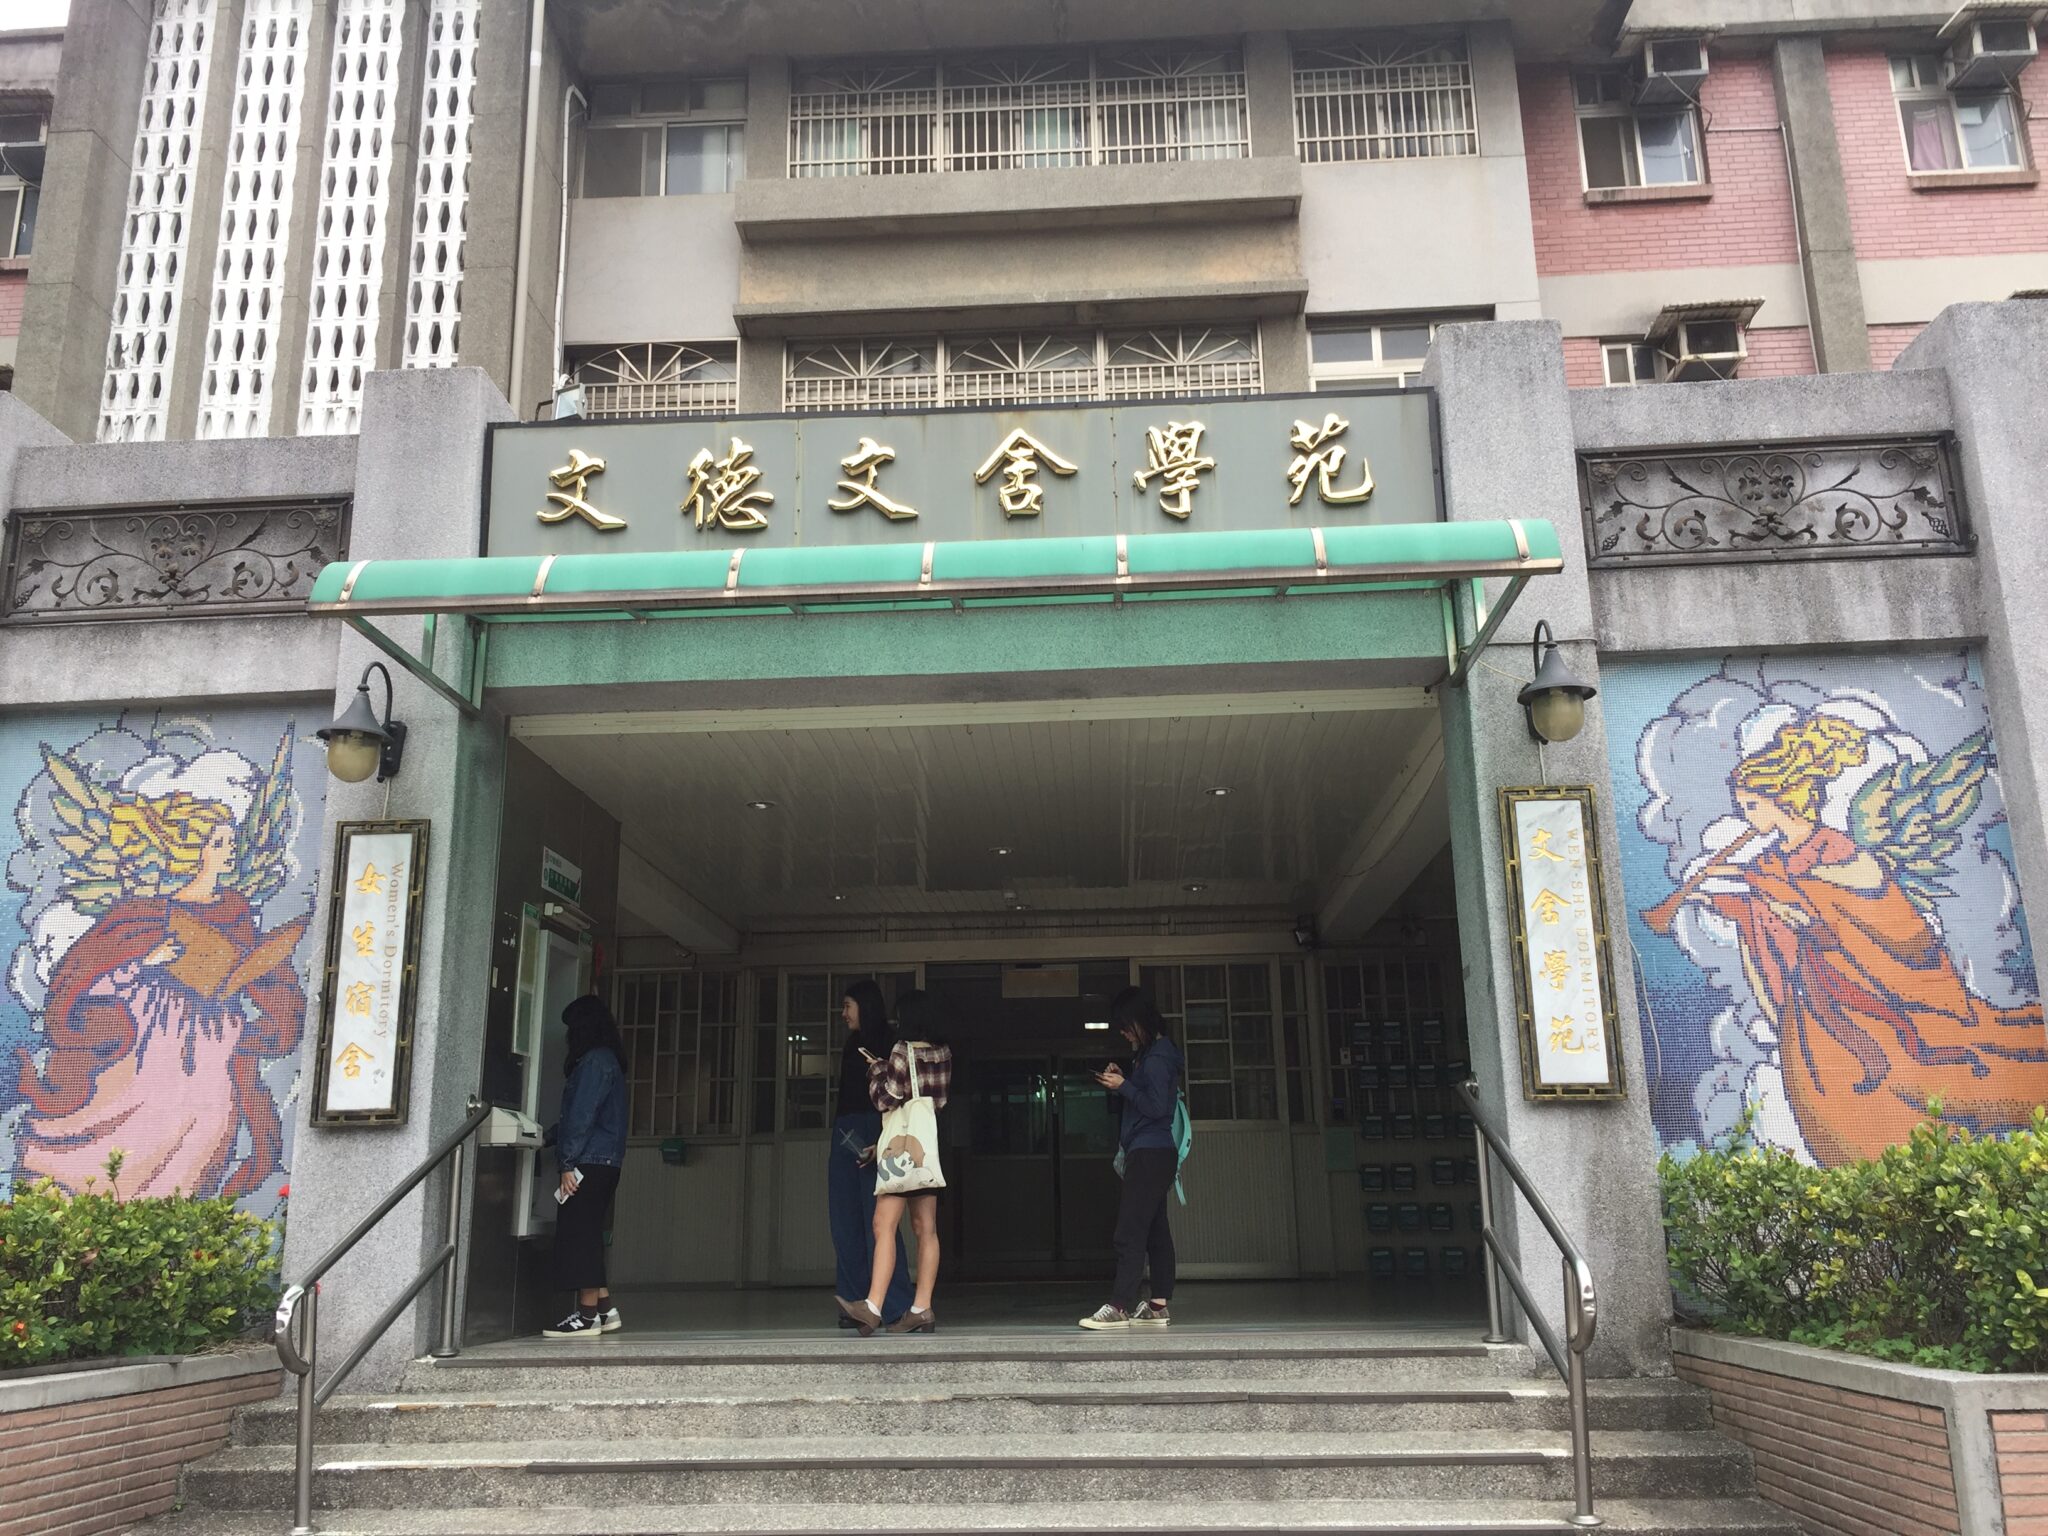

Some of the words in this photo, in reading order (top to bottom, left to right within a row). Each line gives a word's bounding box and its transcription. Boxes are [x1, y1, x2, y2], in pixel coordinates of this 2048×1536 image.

[537, 413, 1374, 530] 文德文舍學苑
[386, 861, 404, 937] Women's
[1529, 828, 1585, 1055] 文舍學苑
[335, 862, 386, 1080] 女生宿舍
[374, 945, 398, 1038] Dormitory
[1576, 928, 1601, 1052] DORMITORY
